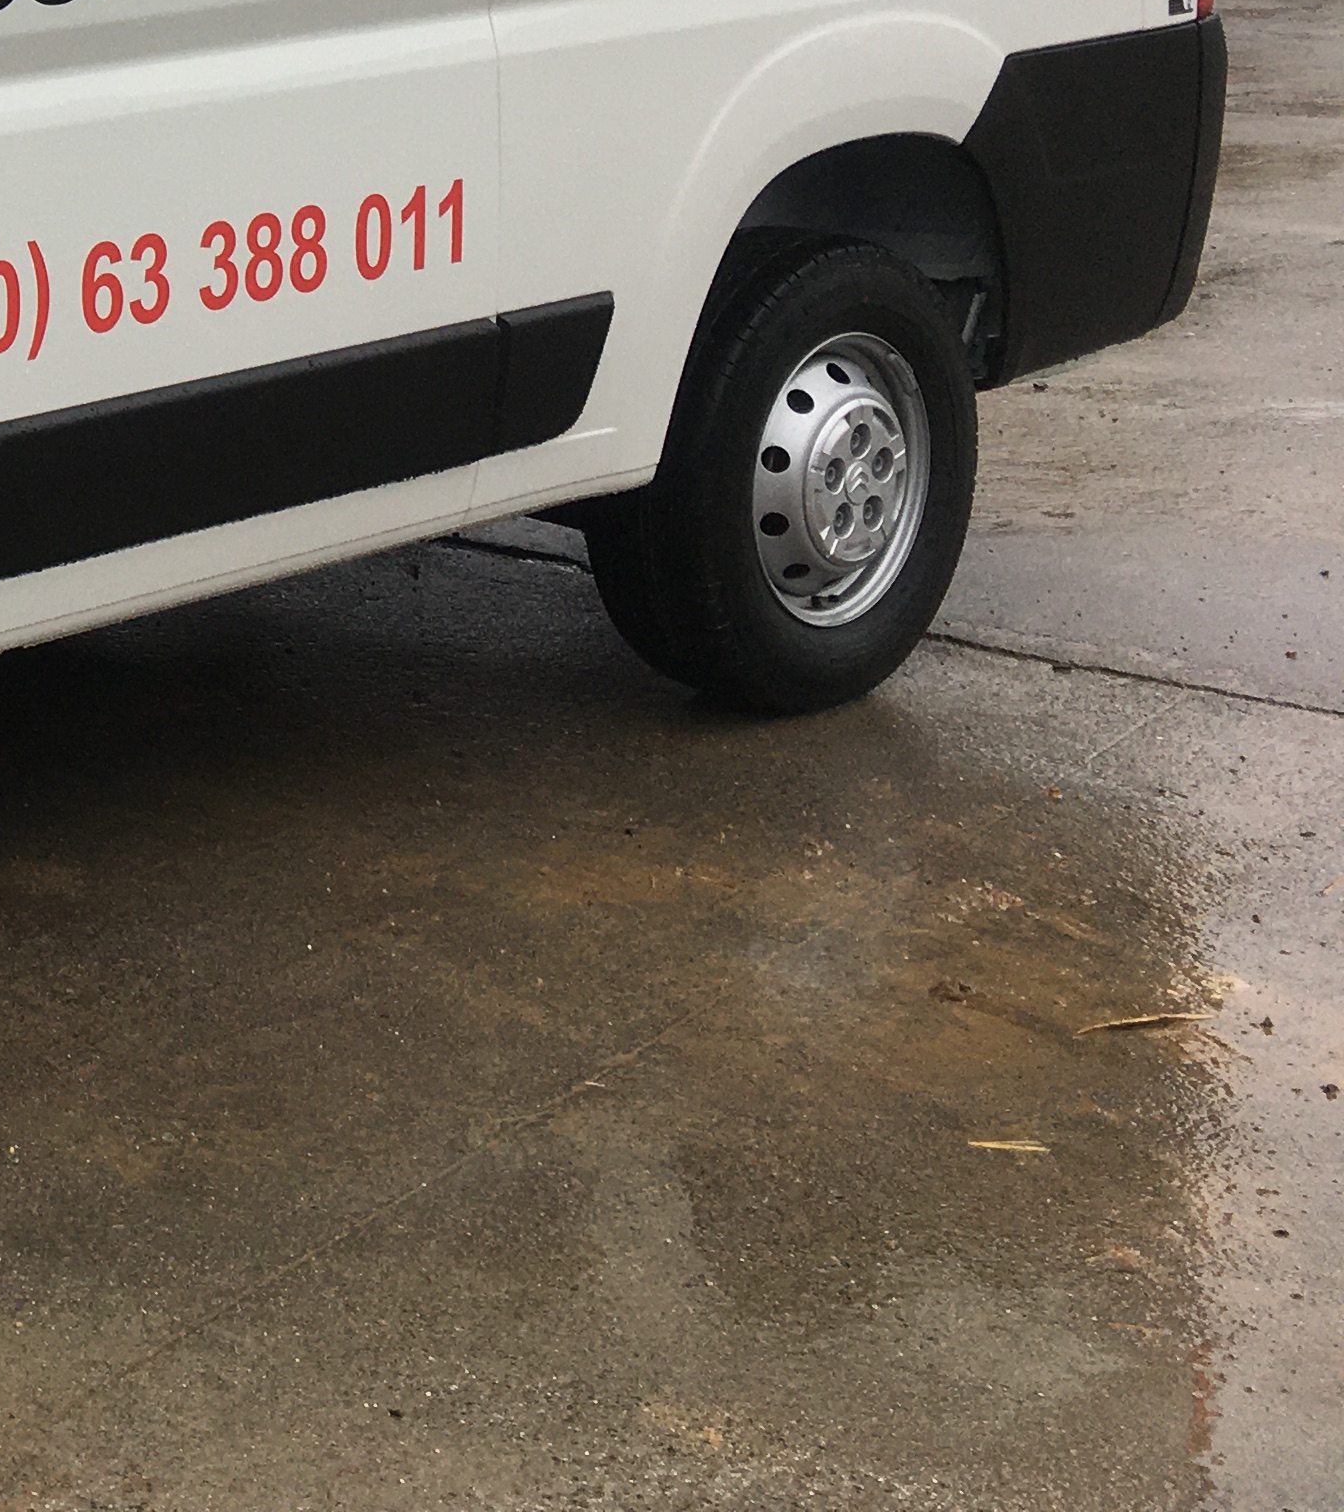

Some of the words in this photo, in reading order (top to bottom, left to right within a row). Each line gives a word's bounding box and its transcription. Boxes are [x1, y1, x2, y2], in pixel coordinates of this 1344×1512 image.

[81, 232, 171, 334] 63
[198, 204, 329, 312] 388
[354, 178, 464, 281] 011
